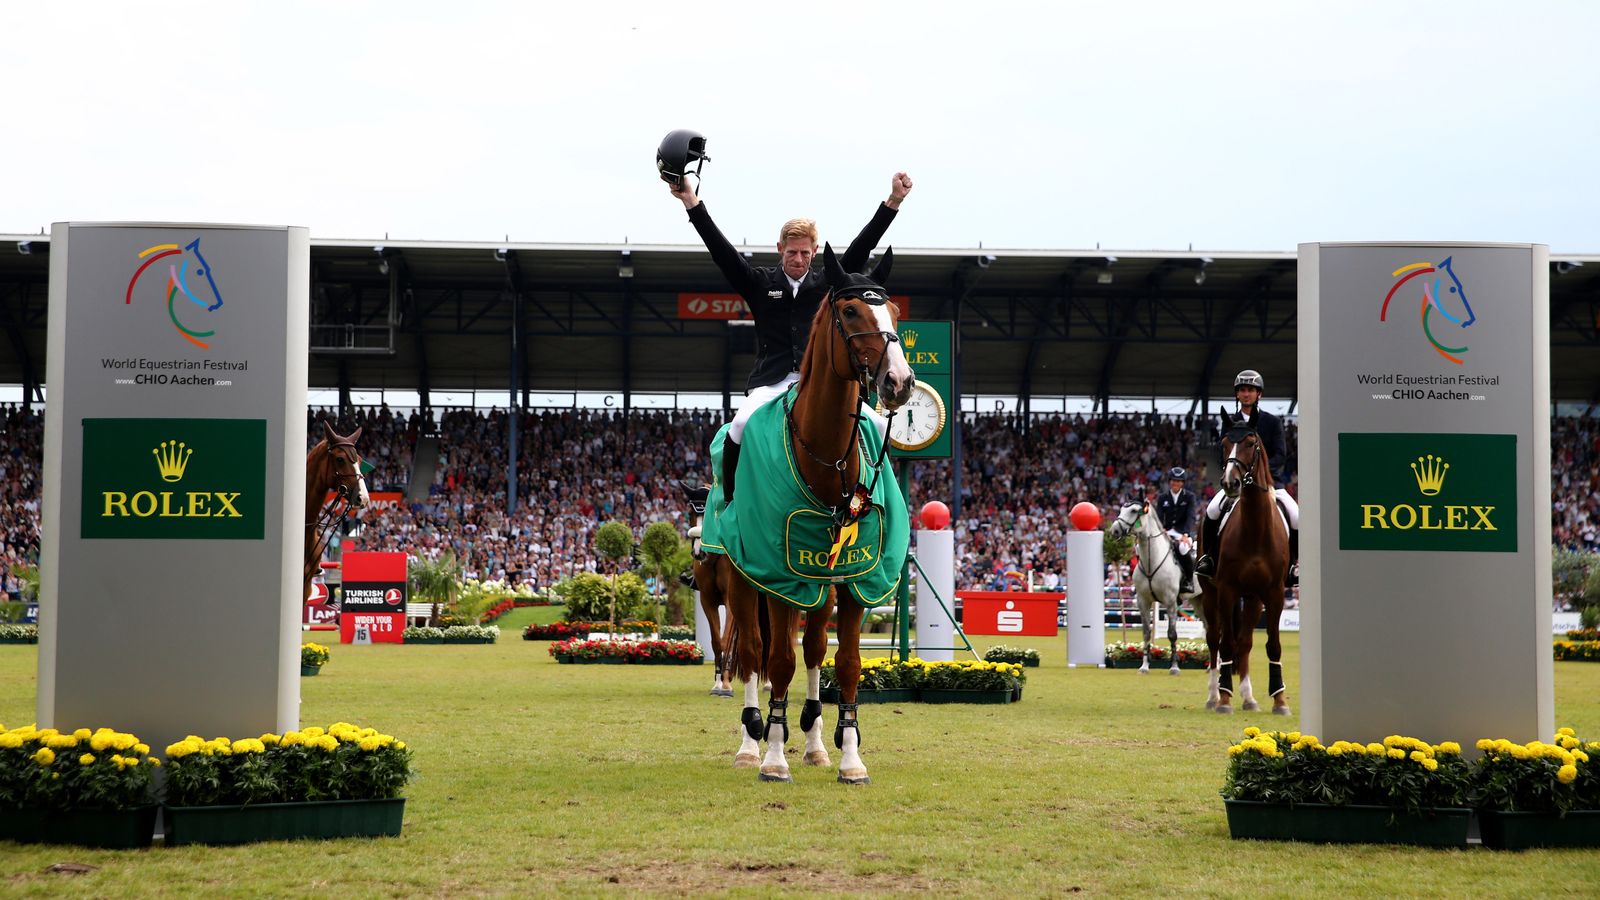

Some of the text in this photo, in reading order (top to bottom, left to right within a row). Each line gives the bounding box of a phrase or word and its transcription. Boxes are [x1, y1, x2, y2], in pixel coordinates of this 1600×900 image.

[906, 352, 939, 364] LEX
[101, 359, 248, 371] World Equestrian Festival
[1357, 374, 1499, 386] World Equestrian Festival
[604, 395, 614, 407] C
[101, 491, 243, 517] ROLEX
[1360, 504, 1498, 531] ROLEX
[354, 616, 393, 624] WIDEN YOUR
[357, 629, 367, 641] 15
